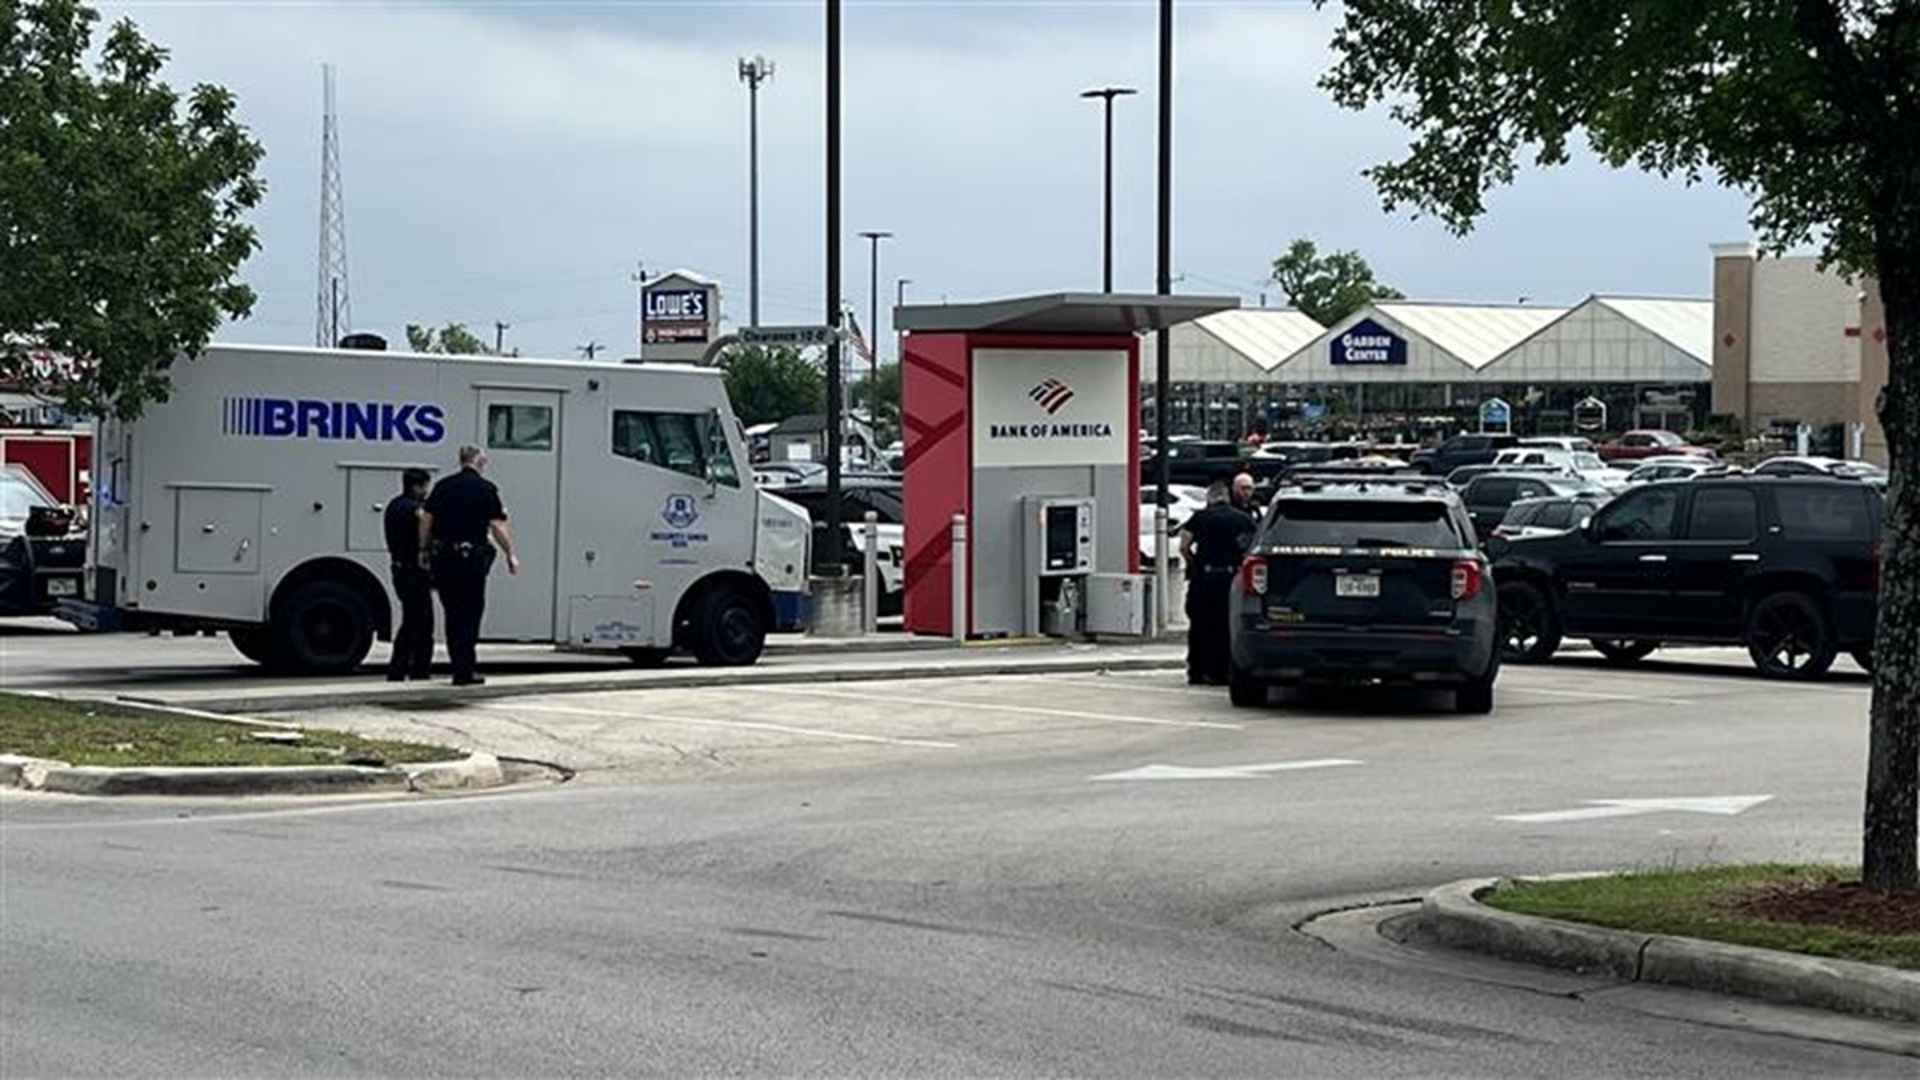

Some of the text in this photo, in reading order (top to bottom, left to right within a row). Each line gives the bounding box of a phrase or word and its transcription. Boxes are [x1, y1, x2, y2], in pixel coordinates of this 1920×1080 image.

[647, 292, 703, 315] LOWE'S
[743, 330, 797, 342] Clearance
[1341, 333, 1391, 348] GARDEN
[1345, 347, 1388, 361] CENTER
[262, 398, 445, 443] BRINKS
[991, 423, 1112, 438] BANK OF AMERICA
[1379, 548, 1436, 557] POLICE
